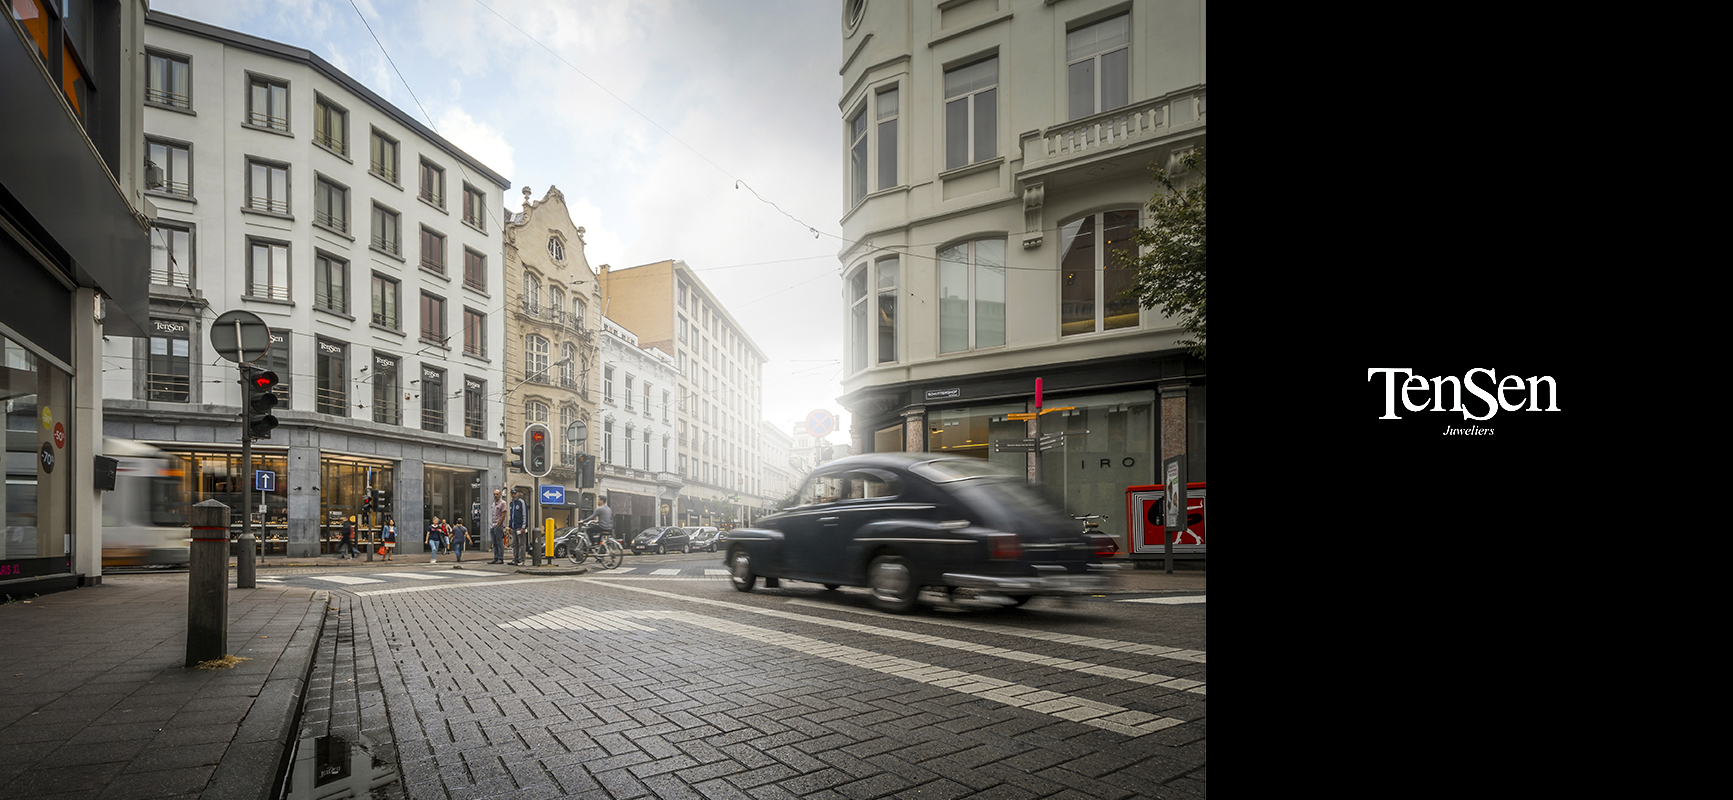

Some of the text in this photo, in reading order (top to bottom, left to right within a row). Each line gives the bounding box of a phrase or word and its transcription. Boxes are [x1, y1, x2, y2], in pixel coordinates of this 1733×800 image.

[154, 321, 184, 332] TenSen
[270, 334, 284, 344] Sen
[1081, 457, 1135, 470] IRO
